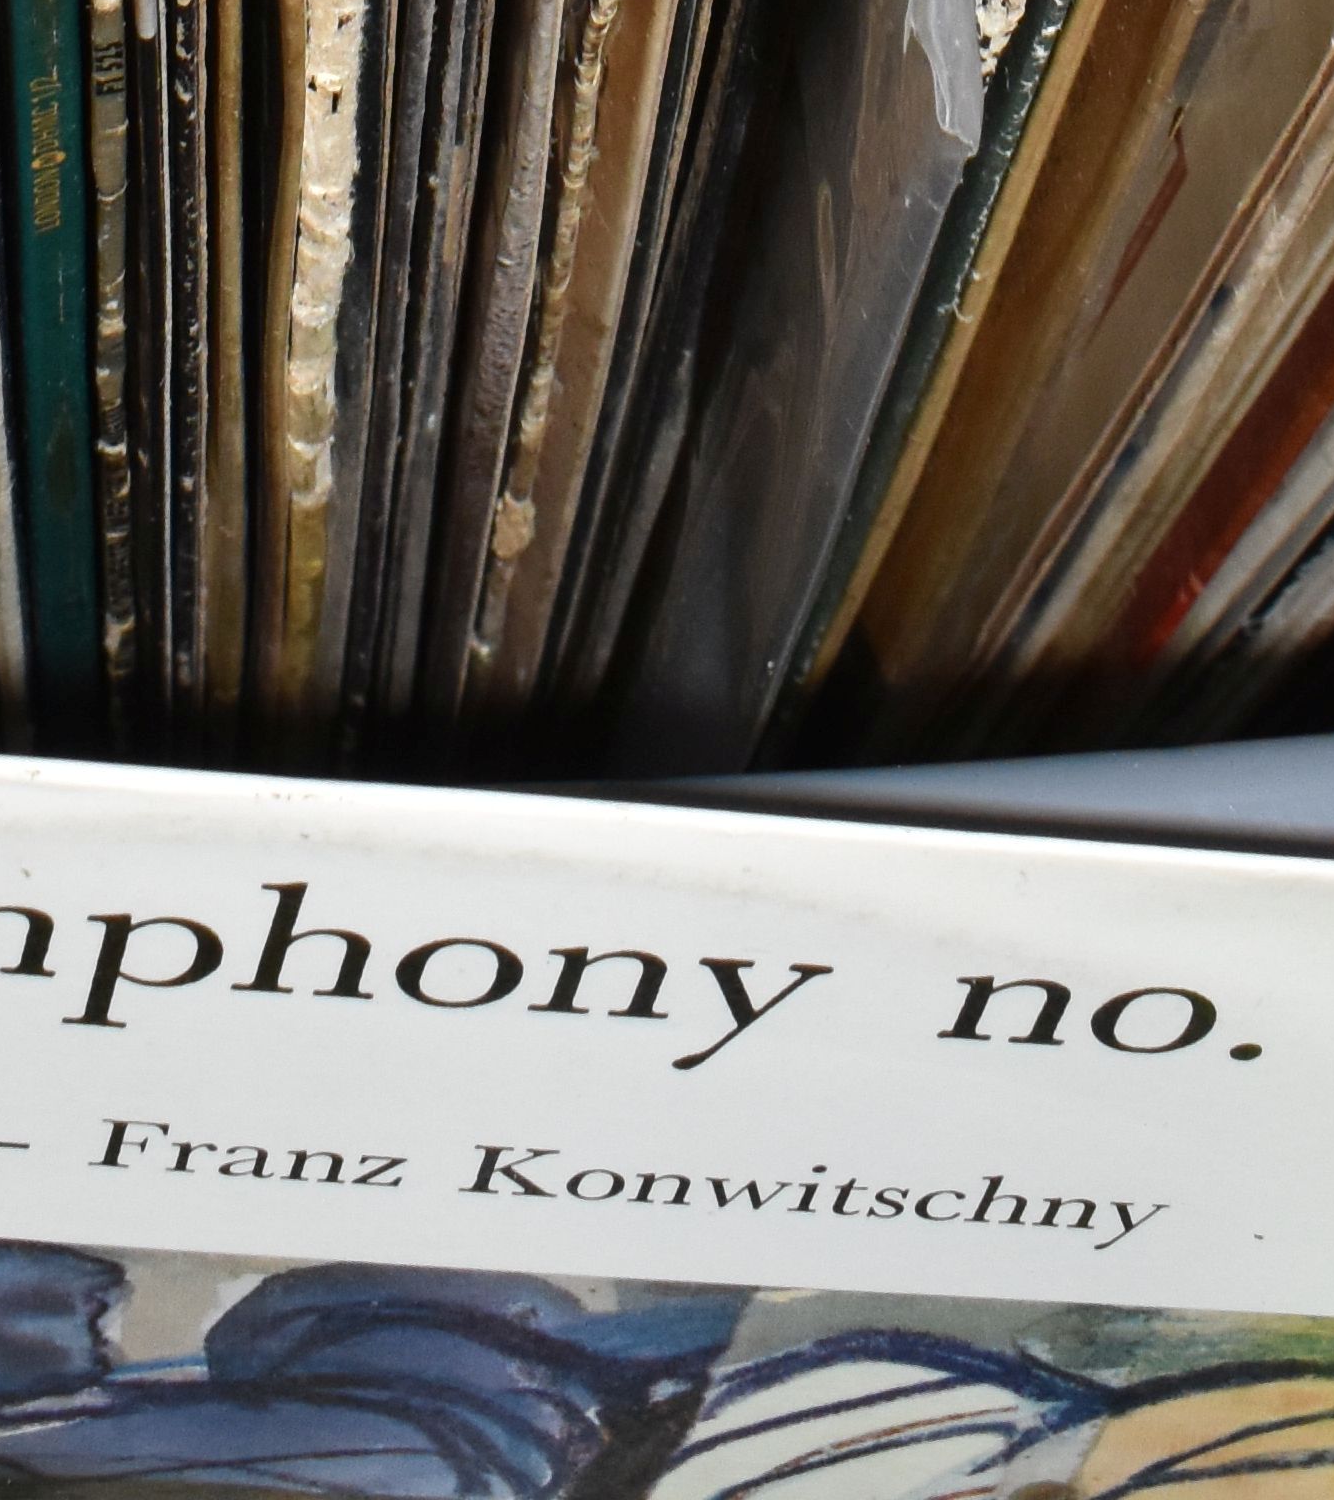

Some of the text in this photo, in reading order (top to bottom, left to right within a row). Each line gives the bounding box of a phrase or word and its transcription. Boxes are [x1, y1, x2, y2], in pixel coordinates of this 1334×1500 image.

[937, 973, 1267, 1062] no.
[94, 1119, 408, 1193] Franz
[463, 1142, 1169, 1250] Konwitschny
